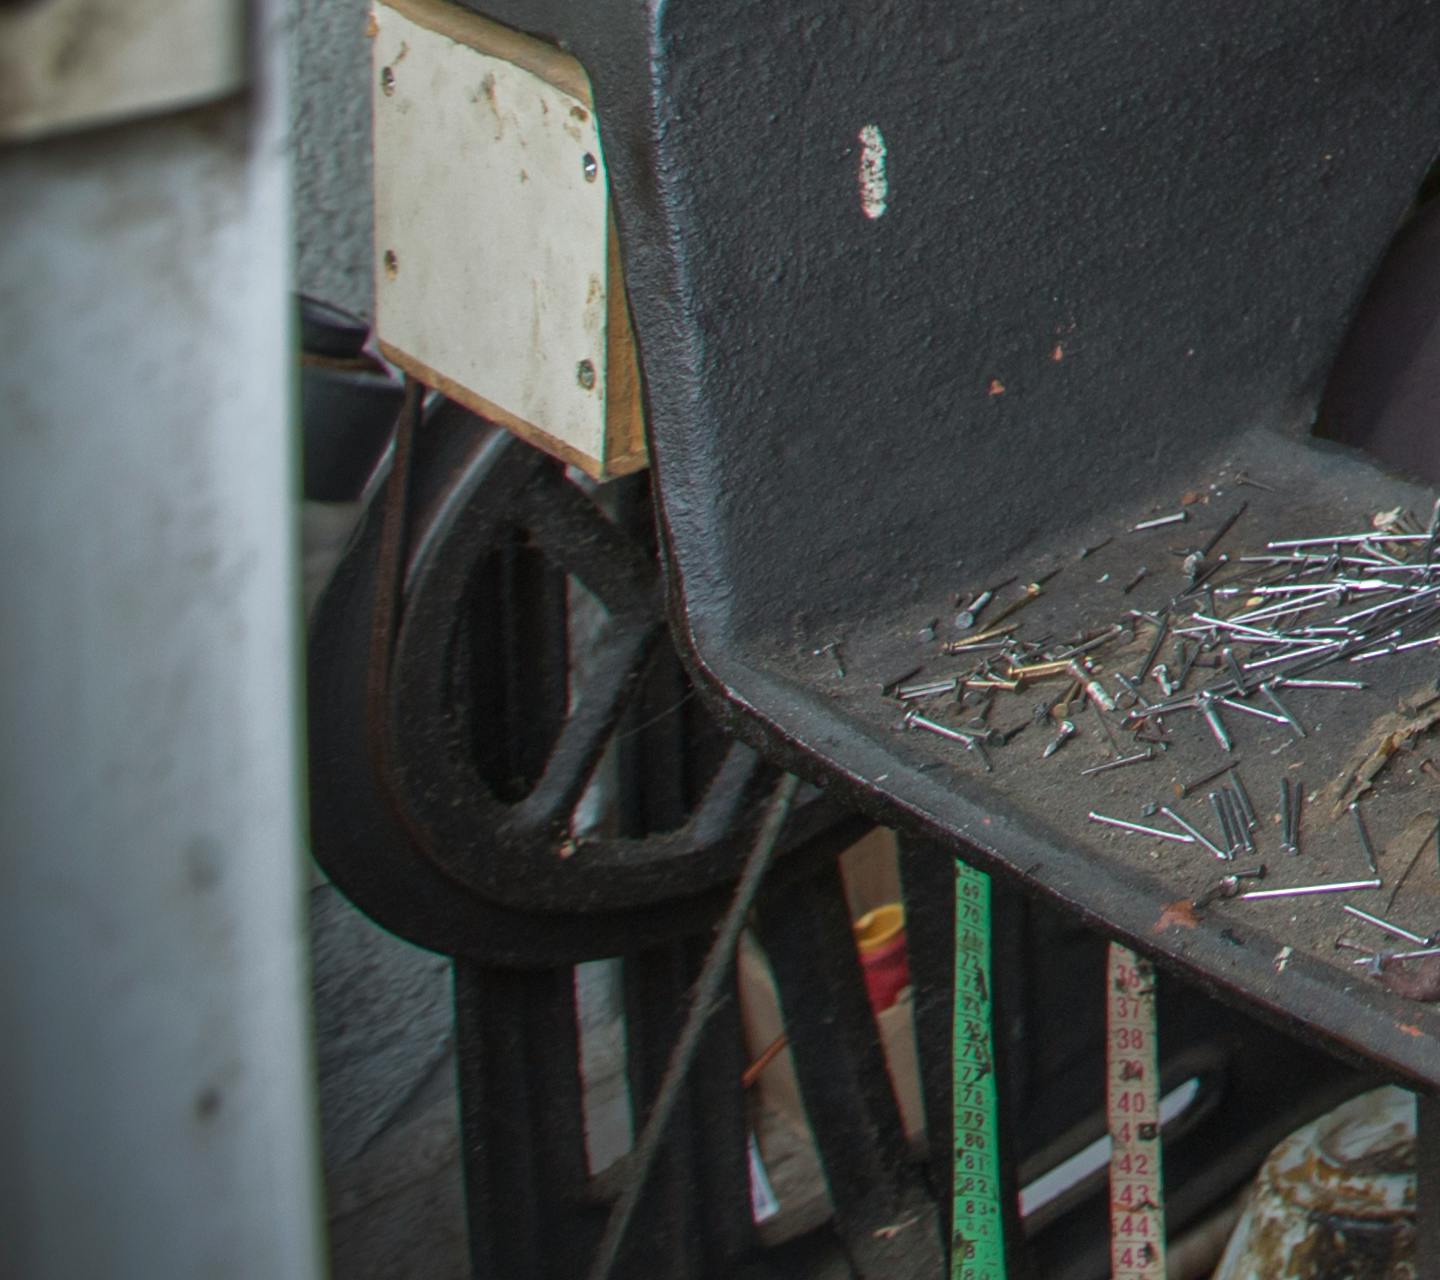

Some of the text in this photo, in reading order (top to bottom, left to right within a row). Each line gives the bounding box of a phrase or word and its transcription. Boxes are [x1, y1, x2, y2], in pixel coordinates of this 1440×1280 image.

[1117, 996, 1140, 1018] 37
[1117, 1028, 1143, 1049] 38
[963, 1088, 983, 1105] 78
[1117, 1091, 1145, 1113] 40
[963, 1111, 984, 1127] 79
[964, 1132, 985, 1149] 80
[964, 1154, 984, 1171] 81
[1118, 1153, 1148, 1175] 42
[964, 1177, 987, 1194] 82
[1119, 1183, 1149, 1205] 43
[965, 1200, 988, 1216] 83
[1120, 1215, 1149, 1237] 44
[1120, 1247, 1150, 1269] 45
